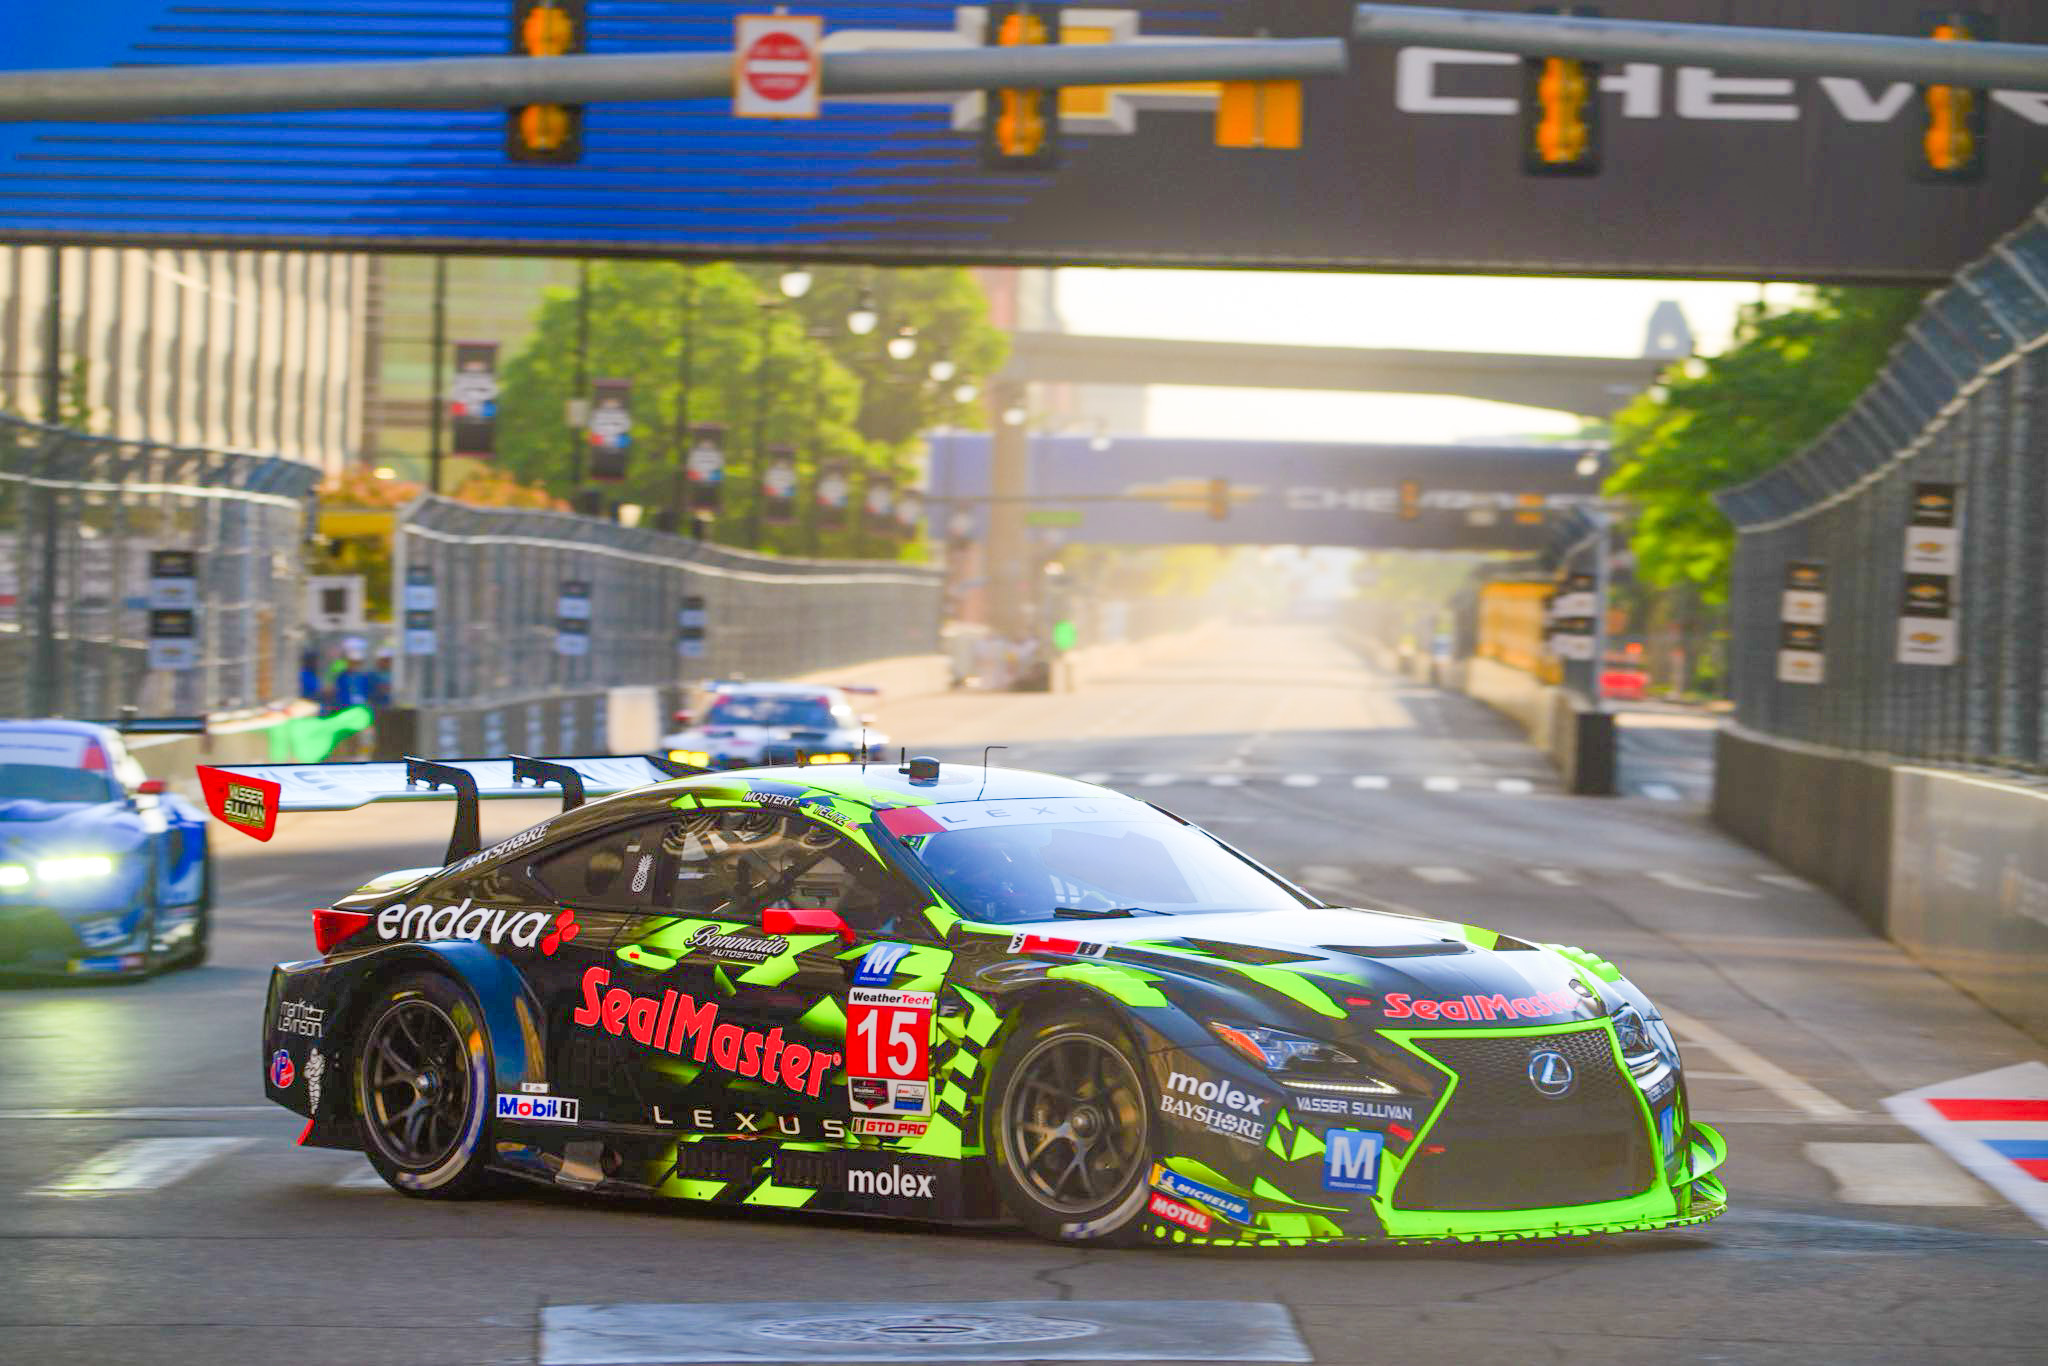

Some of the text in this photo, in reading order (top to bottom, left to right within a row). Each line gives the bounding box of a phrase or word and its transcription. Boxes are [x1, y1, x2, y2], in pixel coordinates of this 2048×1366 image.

[1396, 46, 2048, 125] CHEV
[743, 791, 798, 807] MOSTERT
[377, 898, 552, 948] endava
[685, 924, 788, 955] Bommarito
[711, 949, 768, 961] AUTOSPORT
[853, 991, 932, 1005] WeatherTech
[857, 1008, 918, 1077] 15
[499, 1096, 572, 1118] Mobil 1
[1167, 1071, 1264, 1116] molex
[1296, 1096, 1412, 1120] VASSER SULLIVAN
[653, 1105, 845, 1138] LEXUS
[865, 1121, 928, 1135] GTD PRO
[1160, 1094, 1265, 1140] BAYSHORE
[1330, 1135, 1377, 1180] M
[848, 1164, 933, 1198] molex
[1151, 1197, 1207, 1229] MOTUL
[1176, 1183, 1244, 1213] MICHELIN
